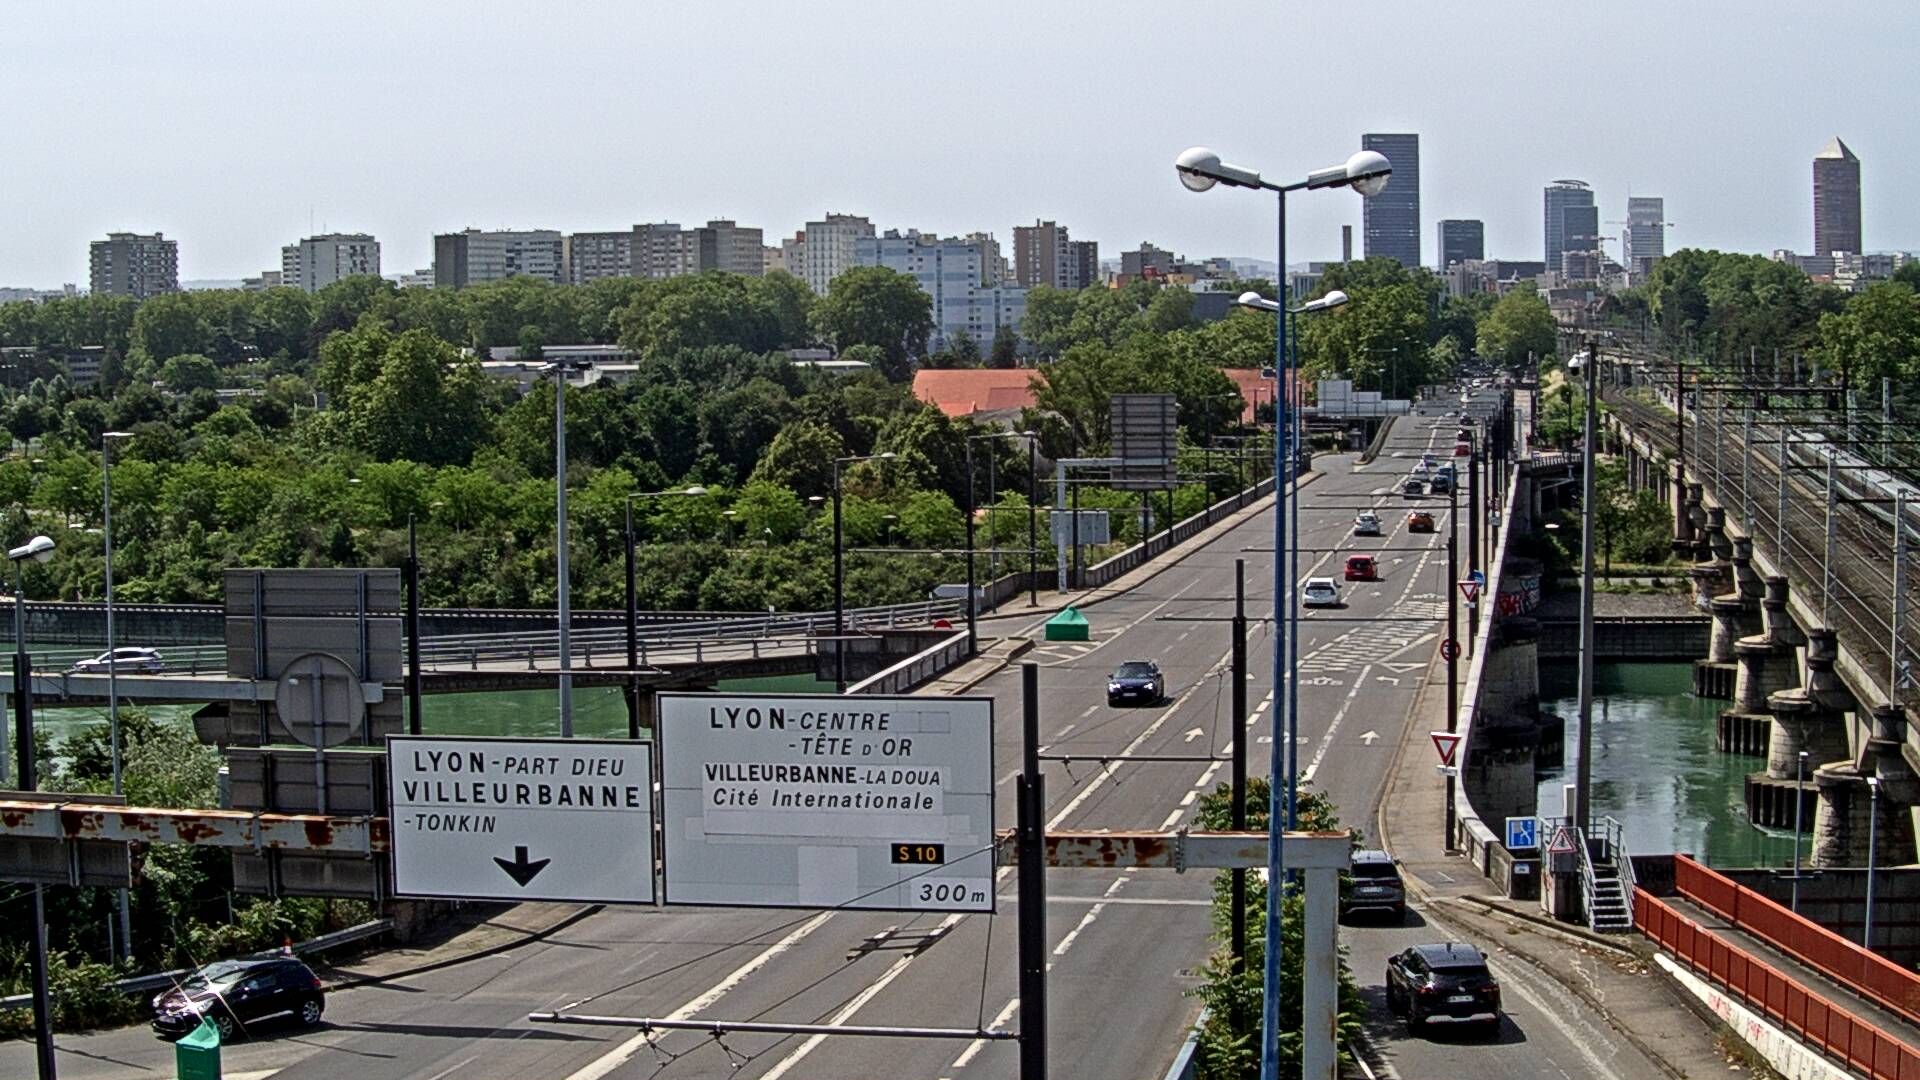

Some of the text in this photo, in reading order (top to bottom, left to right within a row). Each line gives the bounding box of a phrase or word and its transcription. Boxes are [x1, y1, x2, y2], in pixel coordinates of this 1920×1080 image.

[571, 758, 625, 777] DIEU
[891, 770, 941, 786] DOUA
[403, 781, 640, 808] VILLEURBANNE
[713, 787, 934, 810] Cité Internationale
